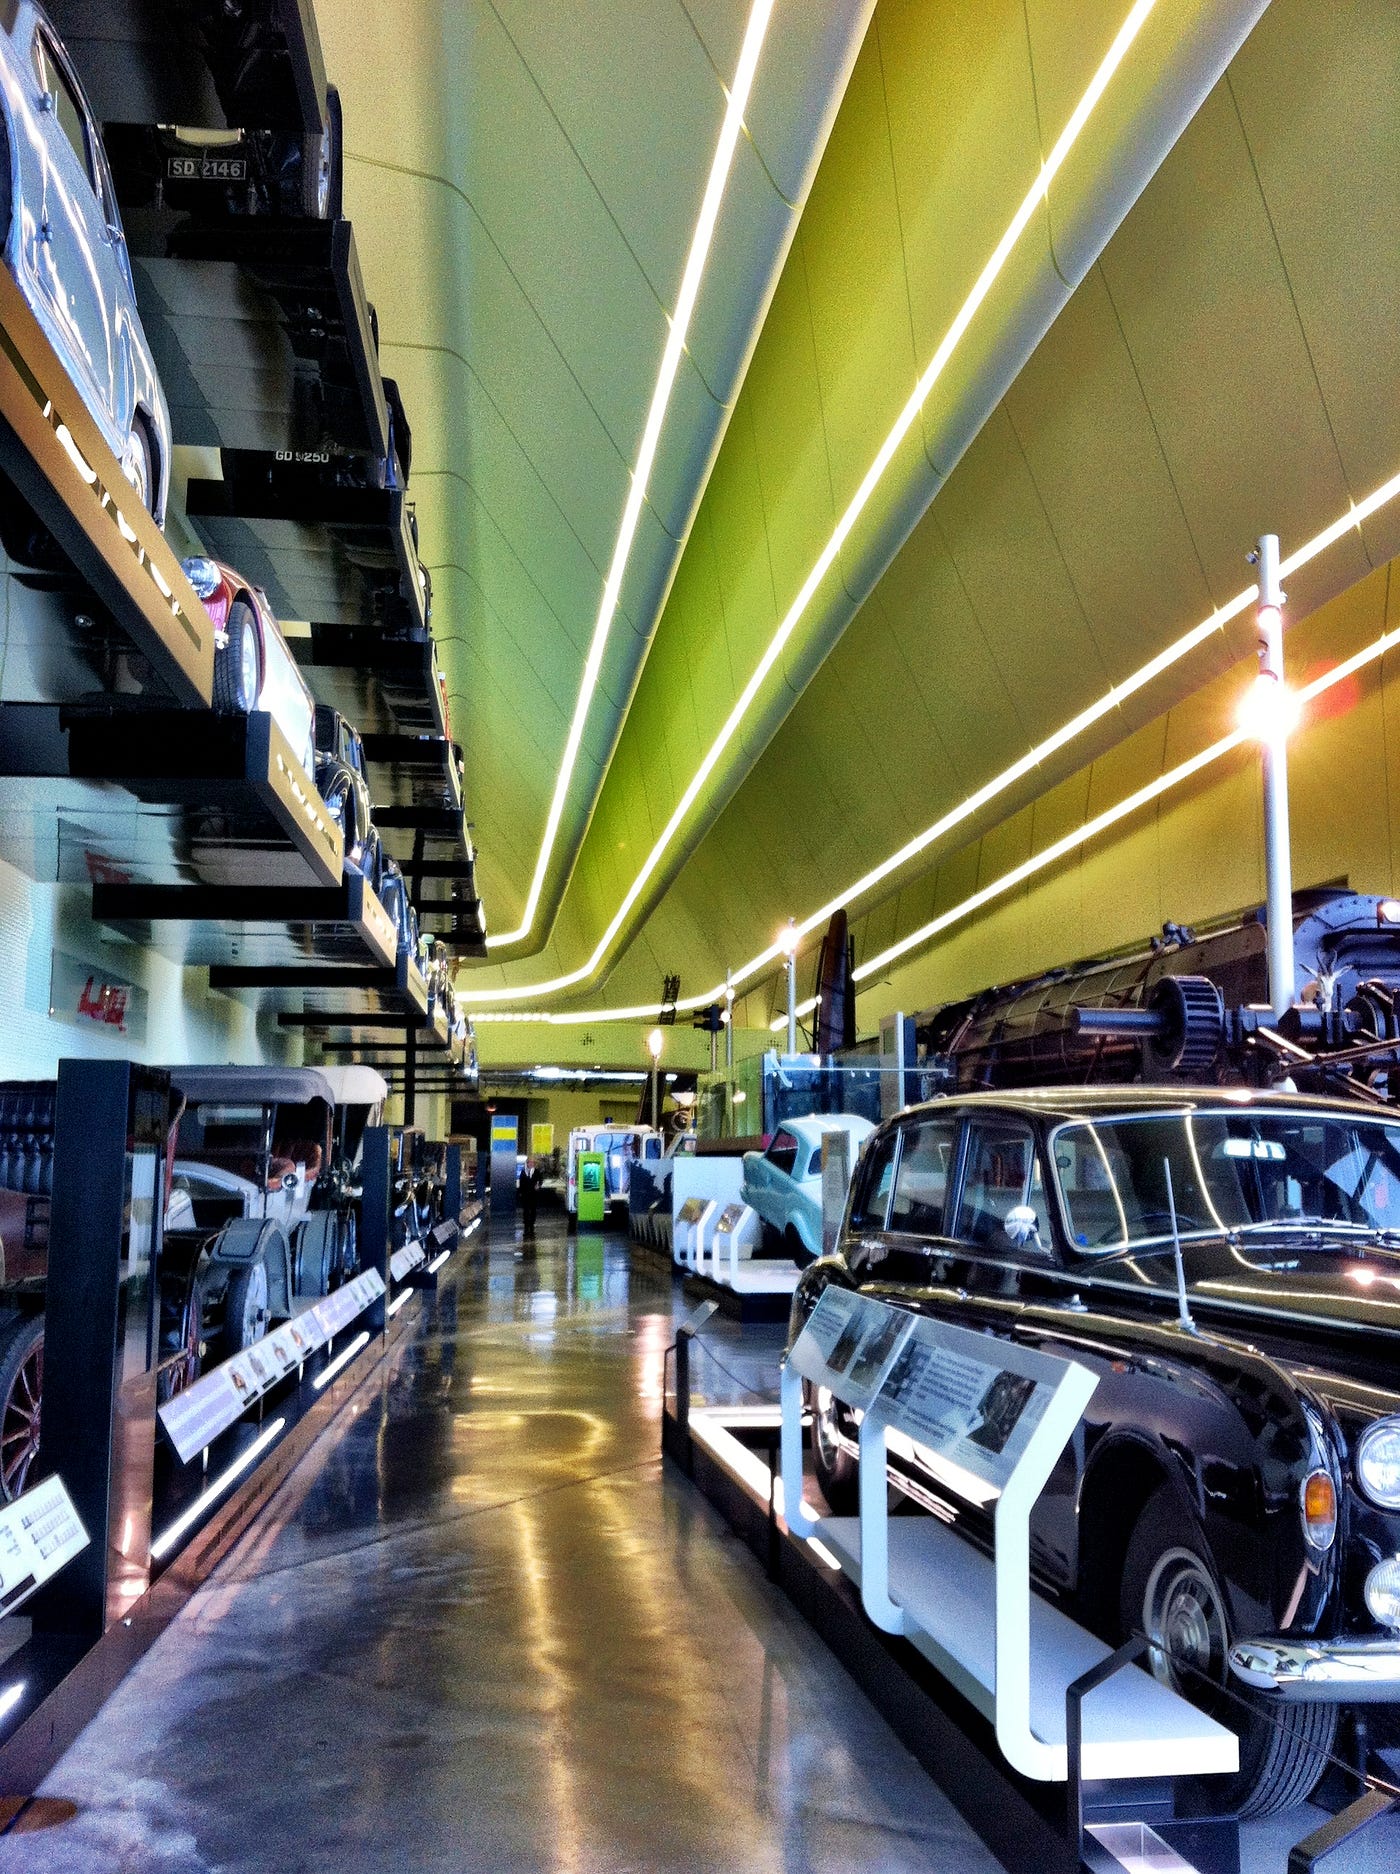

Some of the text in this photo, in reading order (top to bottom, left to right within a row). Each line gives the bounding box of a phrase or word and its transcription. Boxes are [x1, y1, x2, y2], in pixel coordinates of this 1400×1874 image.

[173, 161, 241, 176] SD 2146
[275, 450, 293, 461] GD
